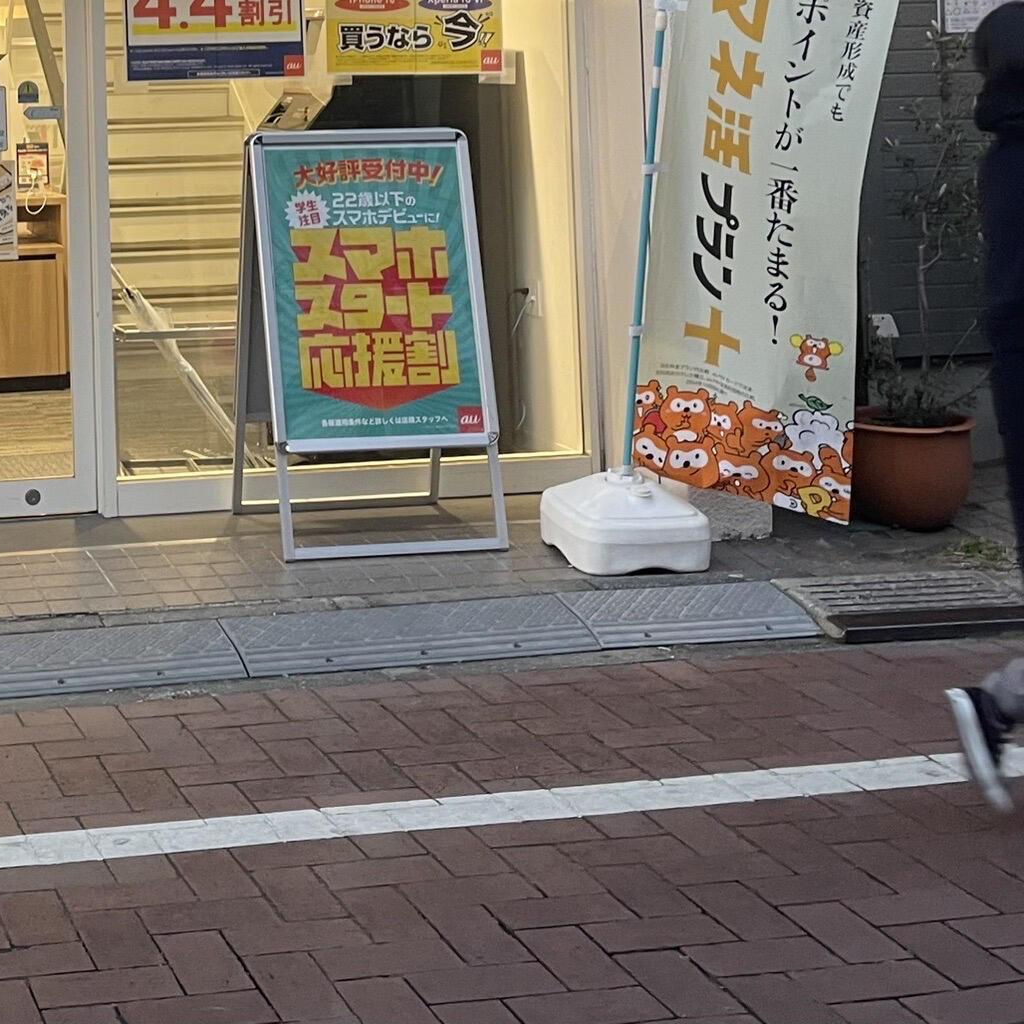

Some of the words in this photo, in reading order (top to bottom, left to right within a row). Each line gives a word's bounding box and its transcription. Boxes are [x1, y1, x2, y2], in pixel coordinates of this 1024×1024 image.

[237, 0, 292, 27] 割引
[338, 24, 433, 51] 買うなら
[286, 61, 303, 69] au
[483, 56, 500, 64] au
[292, 158, 443, 187] 大好評受付中!
[294, 200, 319, 213] 学生
[332, 191, 417, 209] 22歳以下の
[298, 212, 322, 226] 注目
[331, 209, 440, 226] スマホデビューに!
[289, 226, 451, 282] スマホ
[293, 281, 454, 331] スタート
[298, 330, 461, 390] 応援割
[460, 412, 482, 425] au
